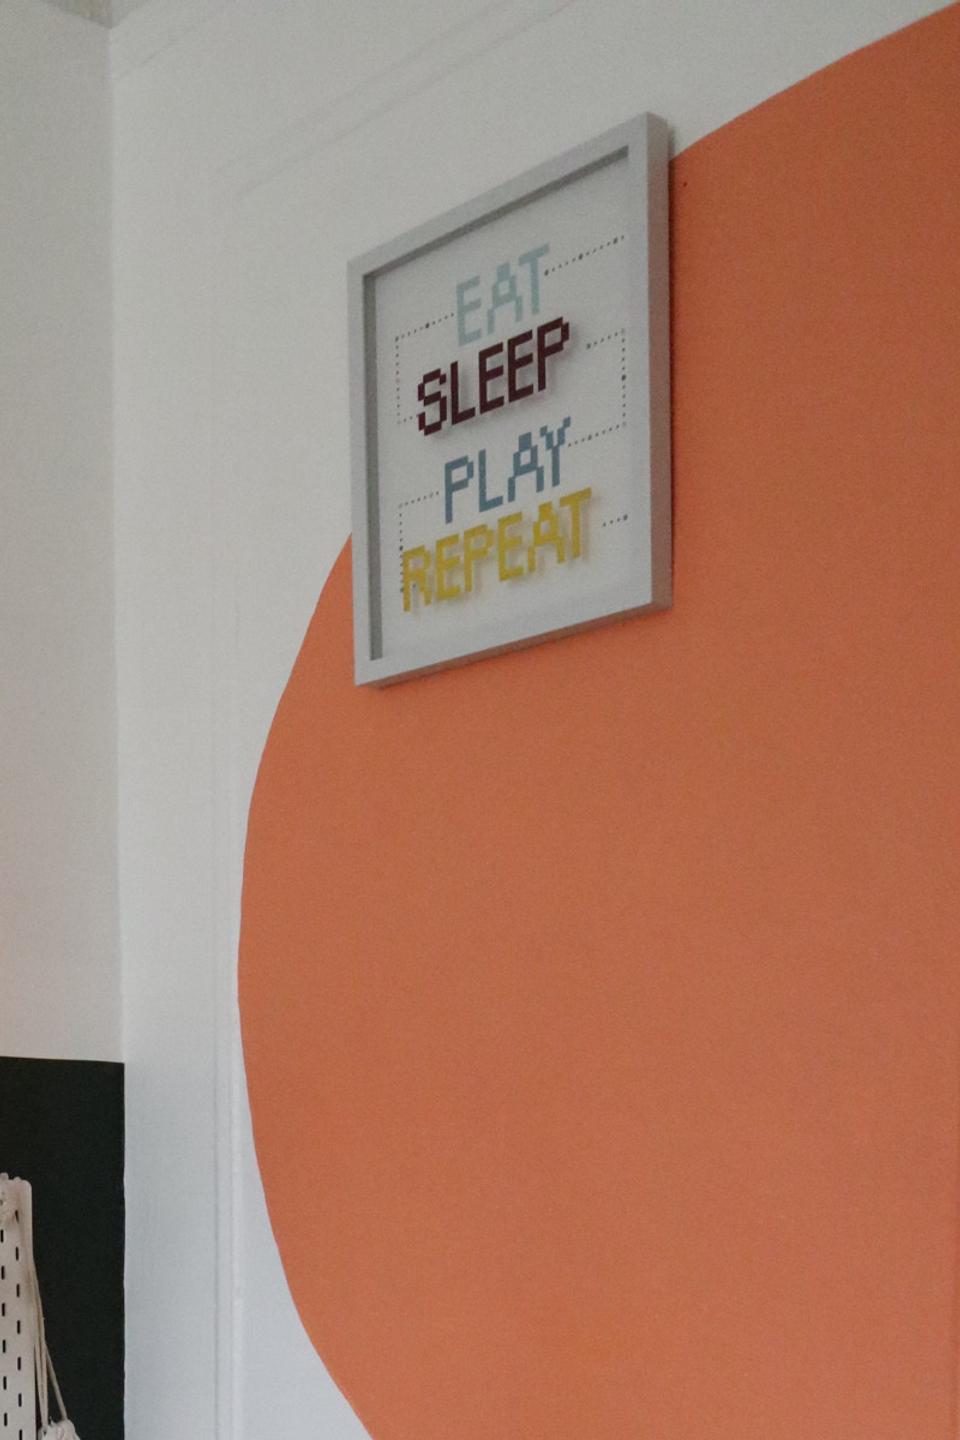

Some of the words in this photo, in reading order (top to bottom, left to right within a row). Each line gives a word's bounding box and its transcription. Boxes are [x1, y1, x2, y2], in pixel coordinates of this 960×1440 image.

[455, 243, 550, 347] EAT
[416, 315, 571, 437] SLEEP
[444, 416, 572, 524] PLAY
[401, 486, 593, 613] REPEAT
